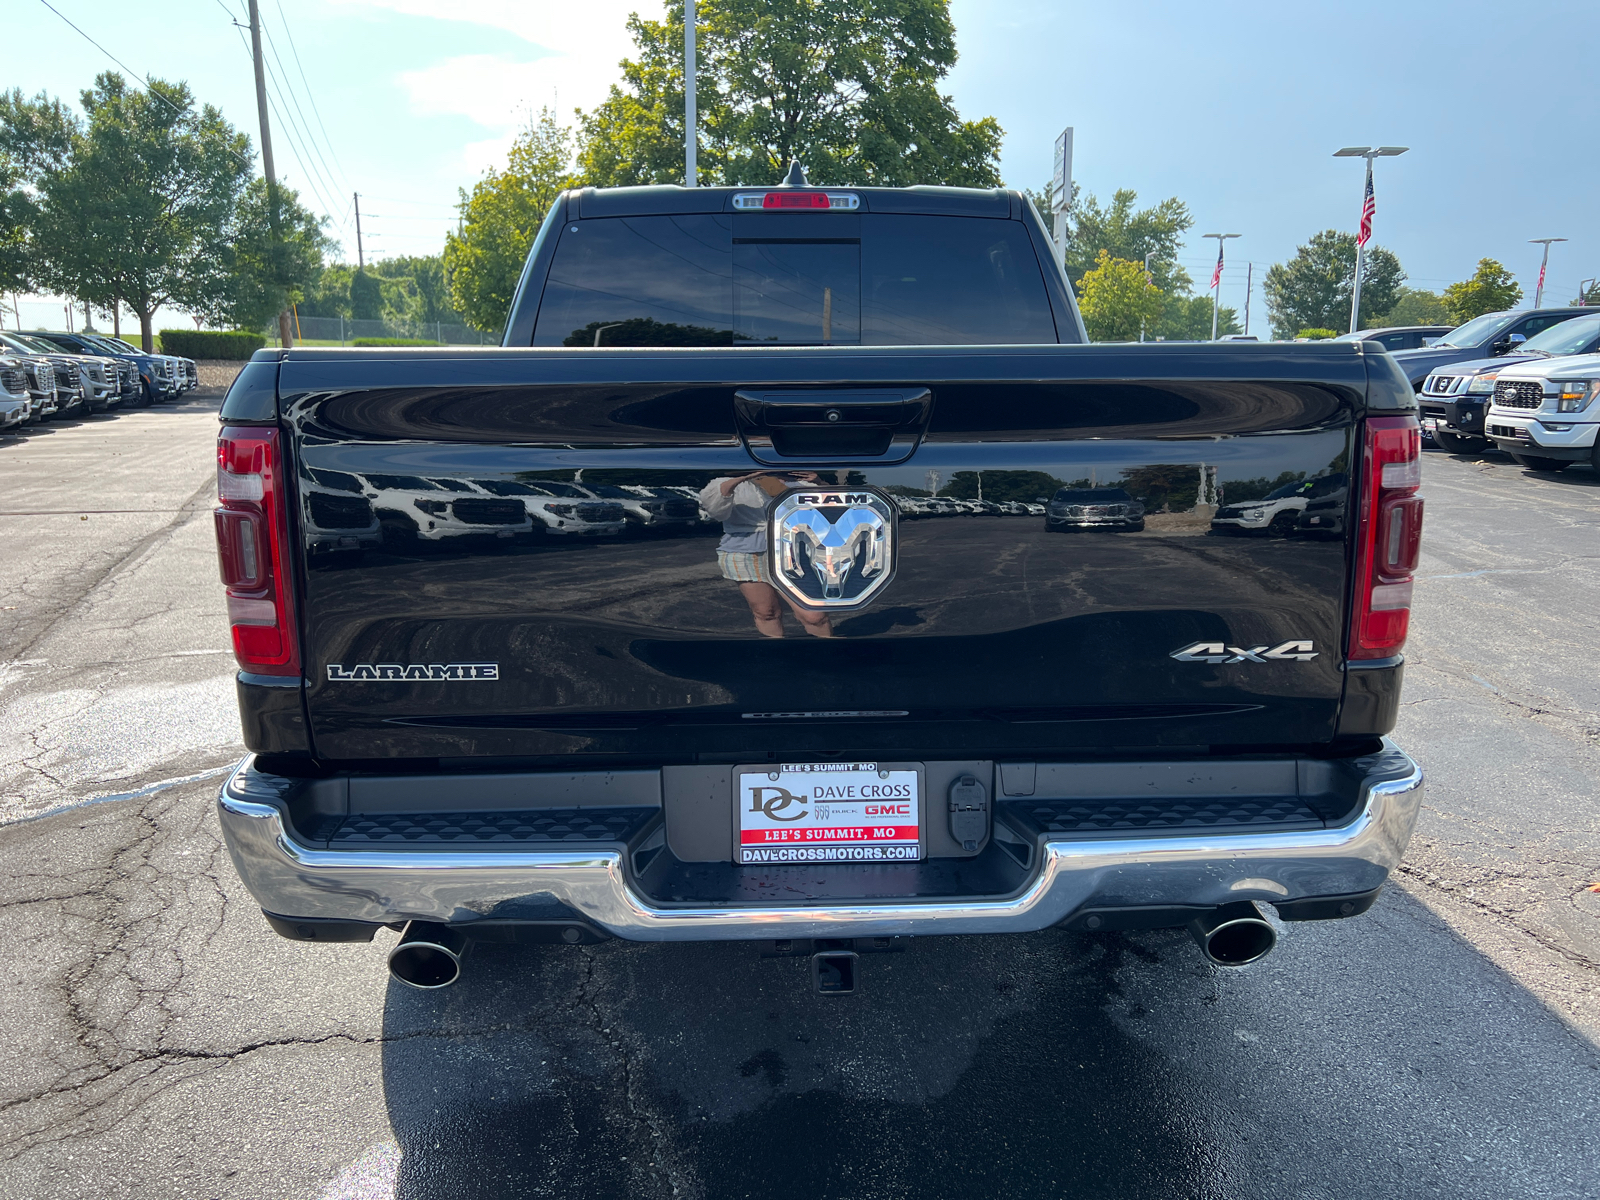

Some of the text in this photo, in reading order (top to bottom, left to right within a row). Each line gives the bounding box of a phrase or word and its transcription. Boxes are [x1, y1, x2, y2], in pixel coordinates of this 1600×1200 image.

[798, 494, 868, 505] RAM
[326, 663, 499, 681] LARAMIE
[782, 763, 875, 772] LEE'S SUMMIT MO
[813, 784, 911, 799] DAVE CROSS
[748, 786, 809, 822] DC
[865, 804, 910, 815] GMC
[764, 828, 896, 841] LEE'S SUMMIT, MO
[742, 847, 918, 862] DAVECROSSMOTORS.COM
